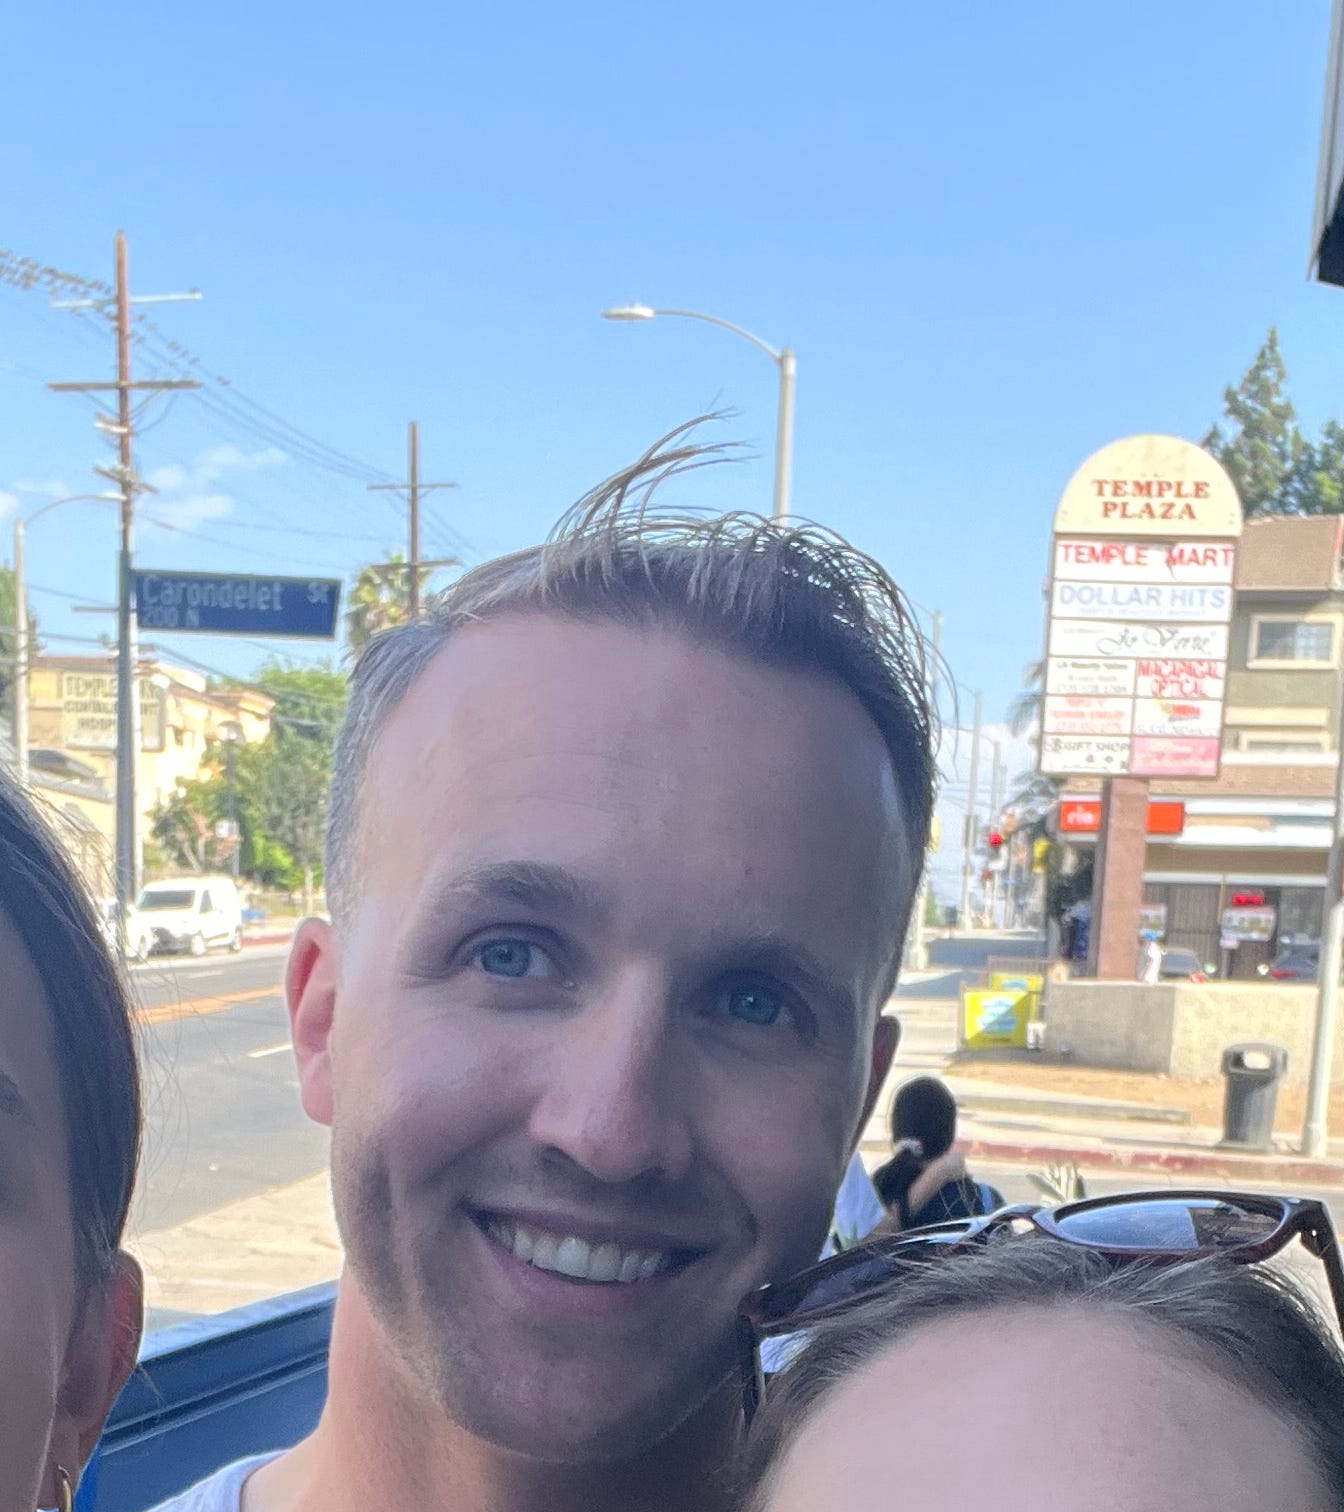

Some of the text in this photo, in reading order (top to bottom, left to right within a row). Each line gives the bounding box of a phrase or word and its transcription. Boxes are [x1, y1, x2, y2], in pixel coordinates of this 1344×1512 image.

[1092, 479, 1210, 499] TEMPLE
[1102, 501, 1197, 520] PLAZA
[1060, 543, 1235, 567] TEMPLE MART
[143, 575, 284, 611] Carondelet
[1060, 584, 1226, 610] DOLLAR HITS
